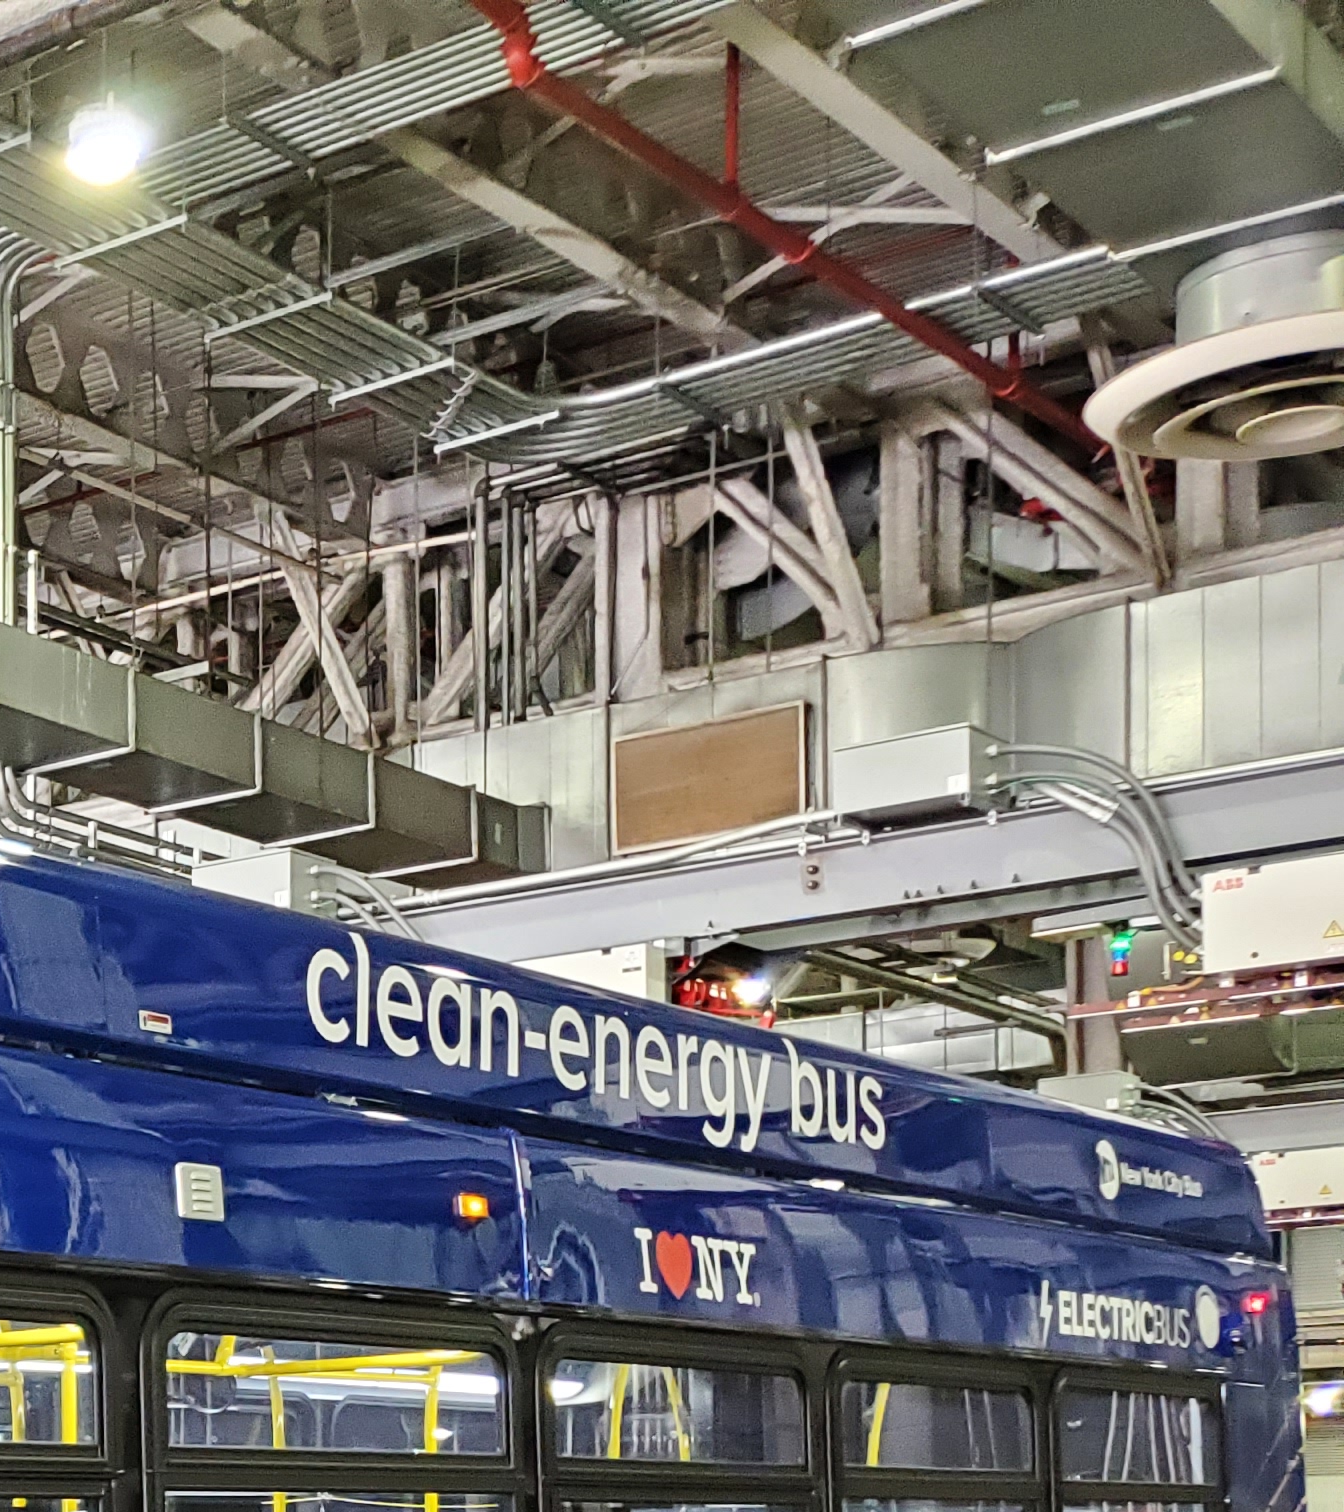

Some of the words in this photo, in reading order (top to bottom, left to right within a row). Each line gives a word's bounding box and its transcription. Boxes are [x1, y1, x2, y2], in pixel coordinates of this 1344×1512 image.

[1213, 877, 1244, 892] ABB
[306, 930, 772, 1152] clean-energy
[784, 1036, 887, 1151] bus
[1120, 1162, 1142, 1186] New
[1163, 1170, 1184, 1198] City
[633, 1227, 658, 1294] I
[691, 1235, 756, 1307] NY
